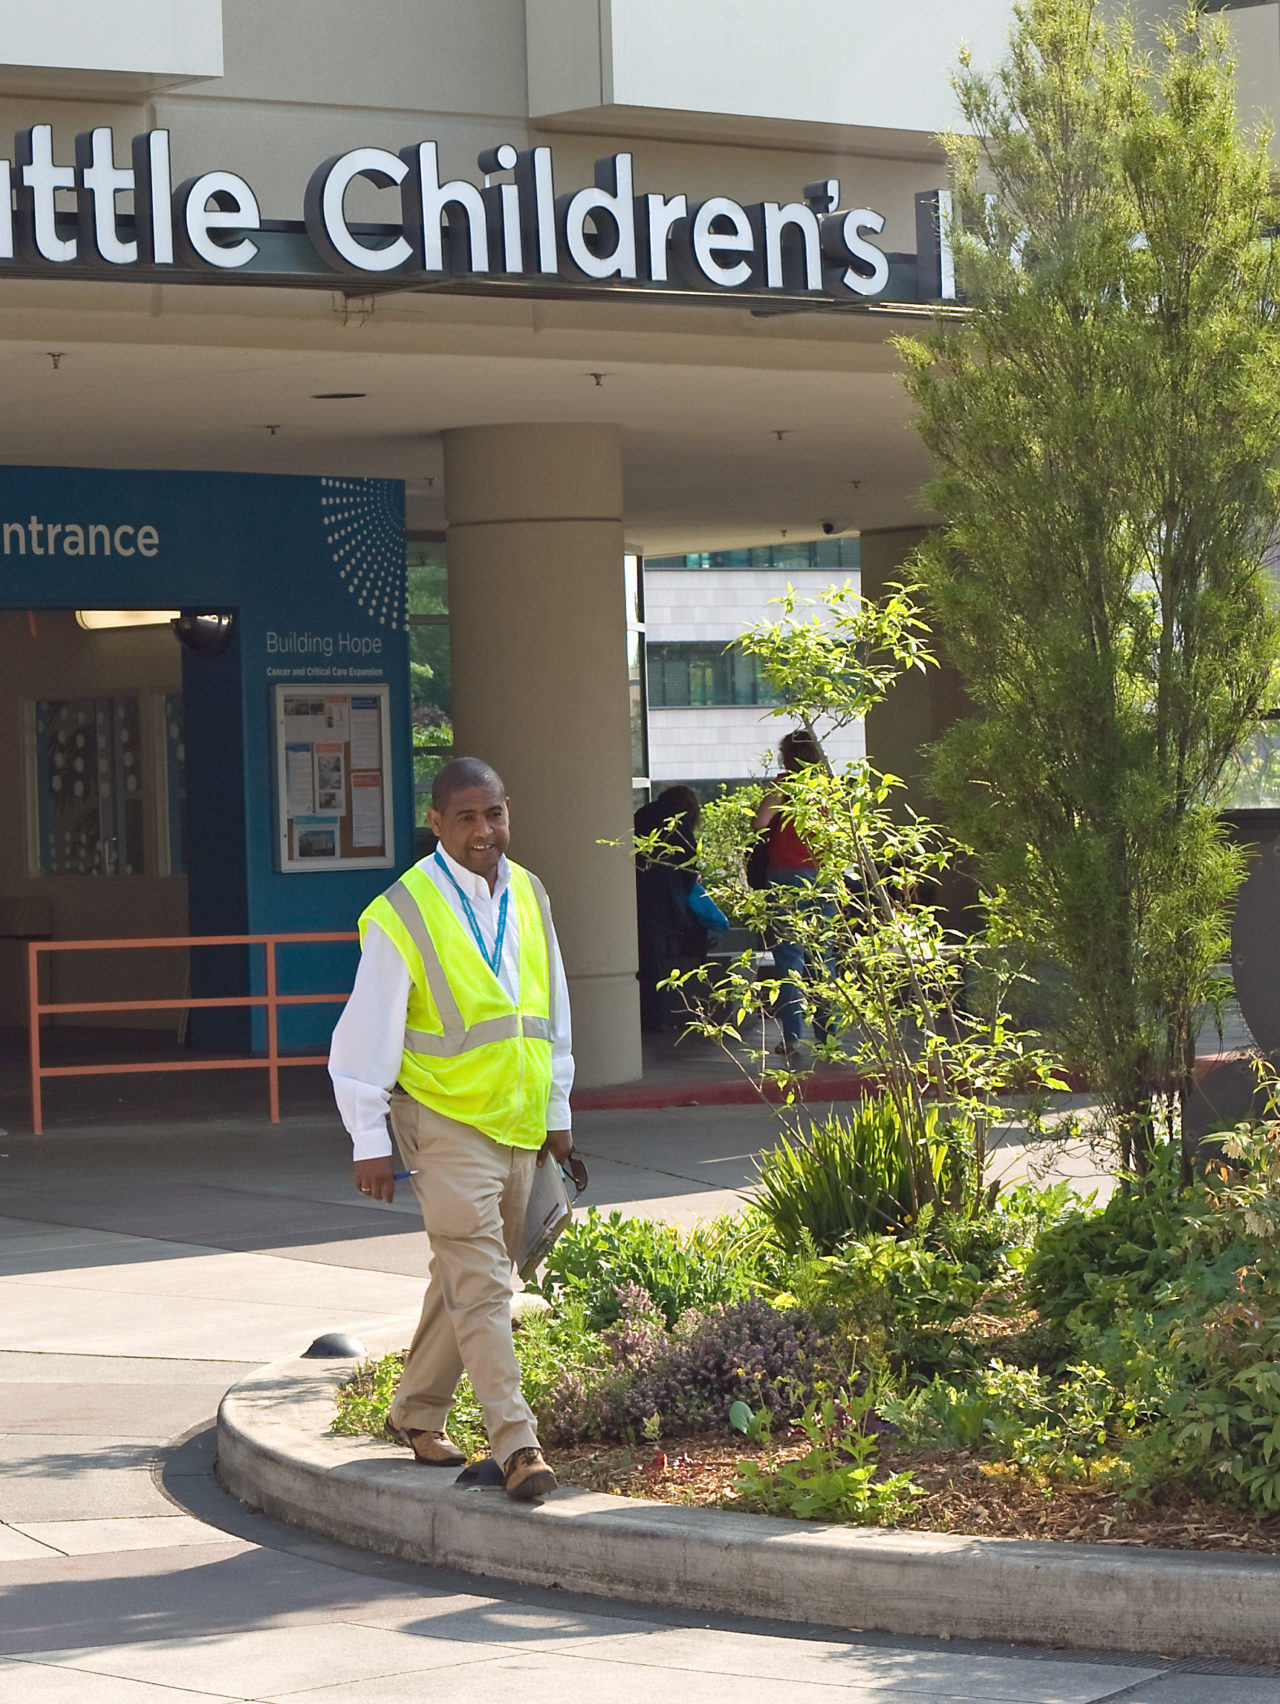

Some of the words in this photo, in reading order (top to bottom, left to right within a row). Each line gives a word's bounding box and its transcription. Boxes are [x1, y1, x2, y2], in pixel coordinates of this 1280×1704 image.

[318, 140, 889, 296] Children's
[266, 631, 333, 656] Building
[338, 632, 382, 656] Hope
[266, 667, 291, 676] Cancer
[292, 667, 305, 676] and
[306, 667, 331, 676] Critical
[332, 667, 347, 676] Care
[348, 667, 383, 677] Expansion
